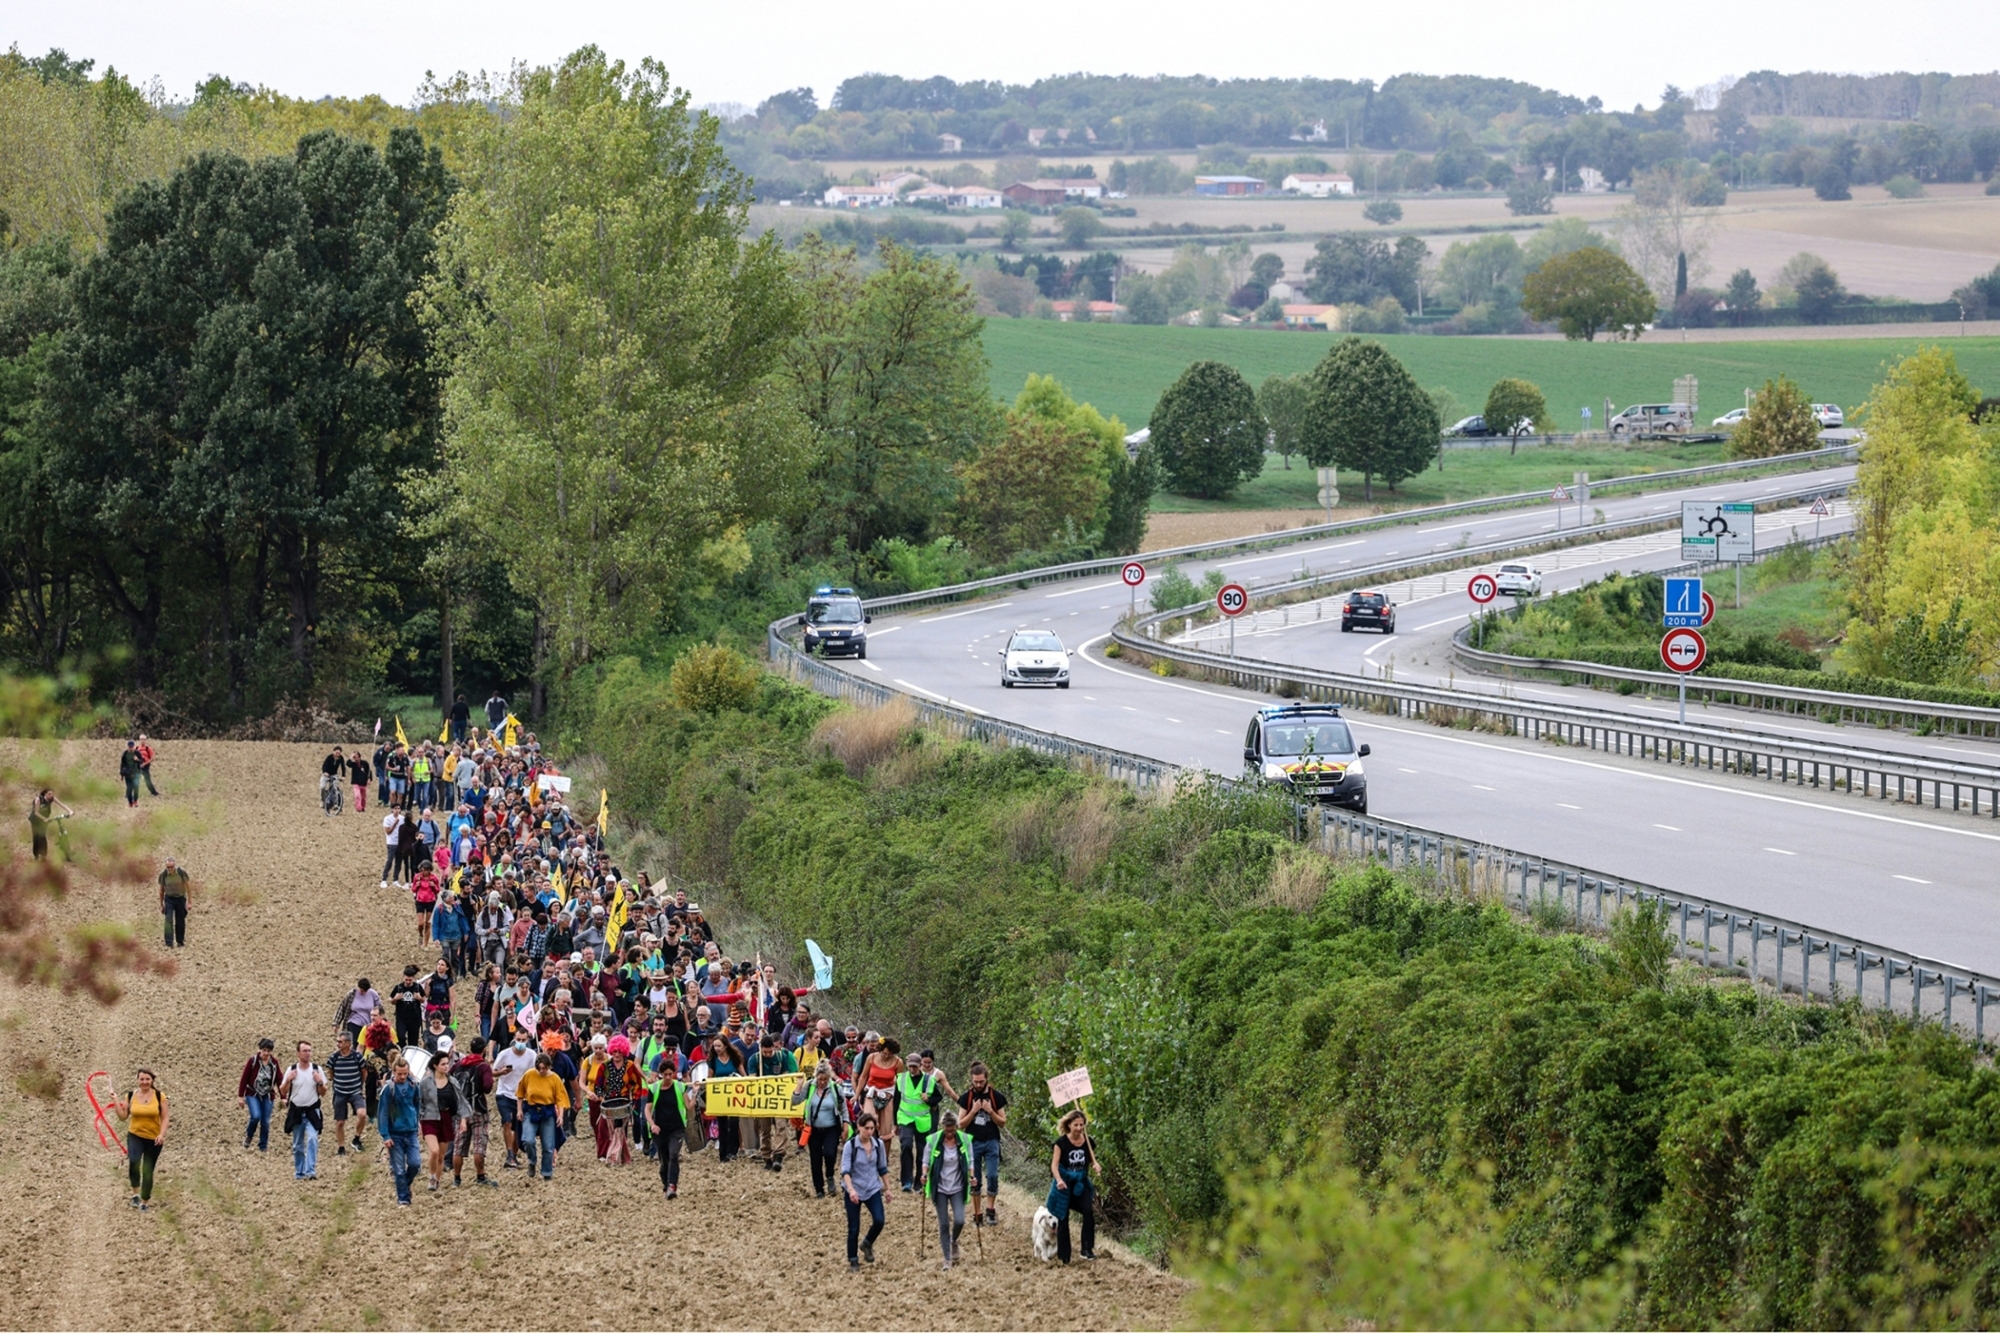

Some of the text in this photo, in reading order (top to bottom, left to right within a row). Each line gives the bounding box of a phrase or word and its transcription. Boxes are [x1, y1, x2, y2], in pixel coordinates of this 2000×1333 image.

[1127, 569, 1140, 580] 70
[1474, 584, 1491, 596] 70
[1224, 593, 1242, 606] 90
[1668, 617, 1686, 625] 200
[1055, 1082, 1071, 1093] NOUS
